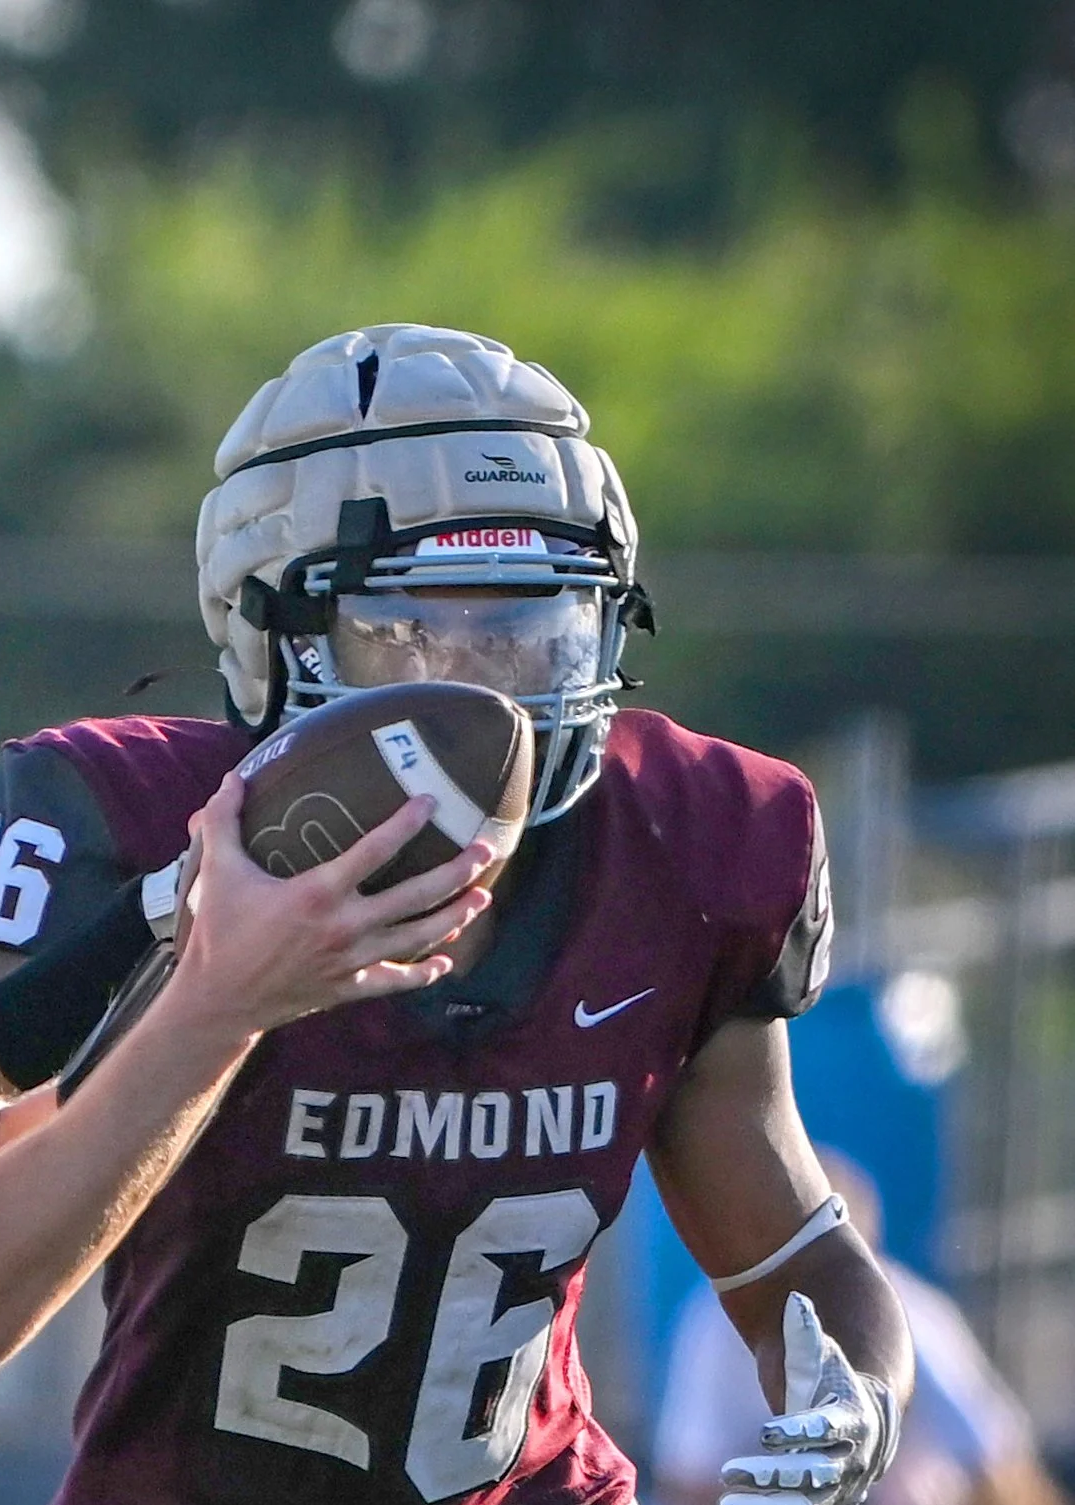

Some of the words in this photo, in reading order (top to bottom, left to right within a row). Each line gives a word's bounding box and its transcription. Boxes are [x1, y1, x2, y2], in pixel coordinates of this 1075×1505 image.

[464, 469, 546, 485] GUARDIAN
[436, 527, 532, 547] Riddell
[284, 1081, 619, 1160] EDMOND
[213, 1187, 601, 1503] 26
